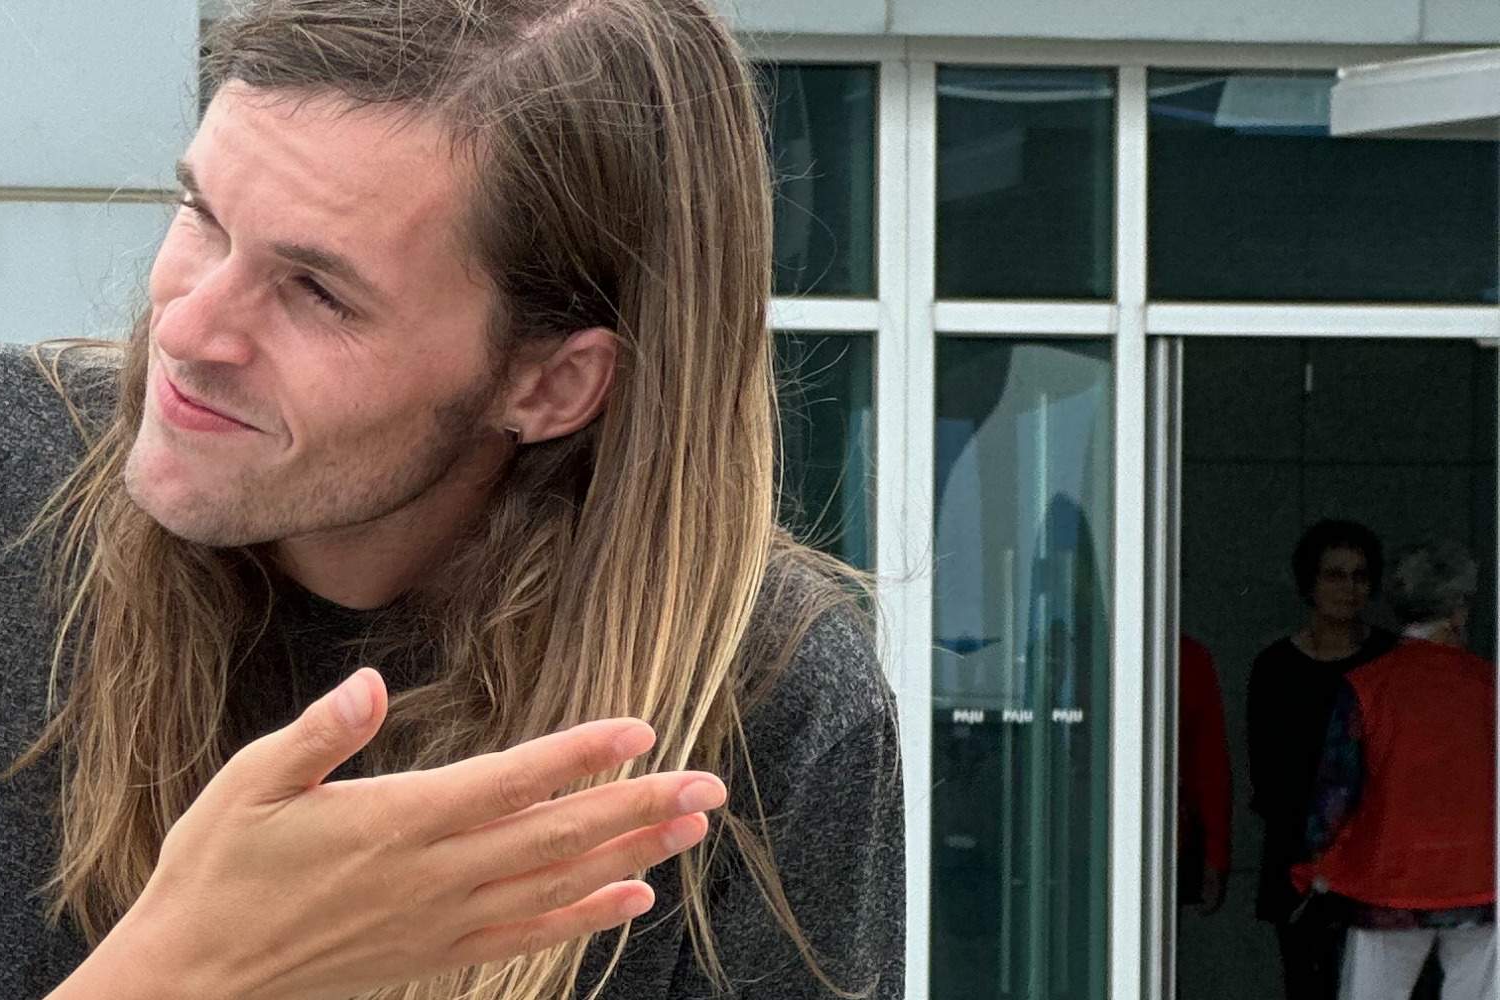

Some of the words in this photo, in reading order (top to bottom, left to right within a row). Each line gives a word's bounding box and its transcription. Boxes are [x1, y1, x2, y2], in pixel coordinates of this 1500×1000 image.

[953, 709, 984, 723] PAJU
[1002, 709, 1033, 723] PAJU
[1051, 709, 1083, 723] PAJU
